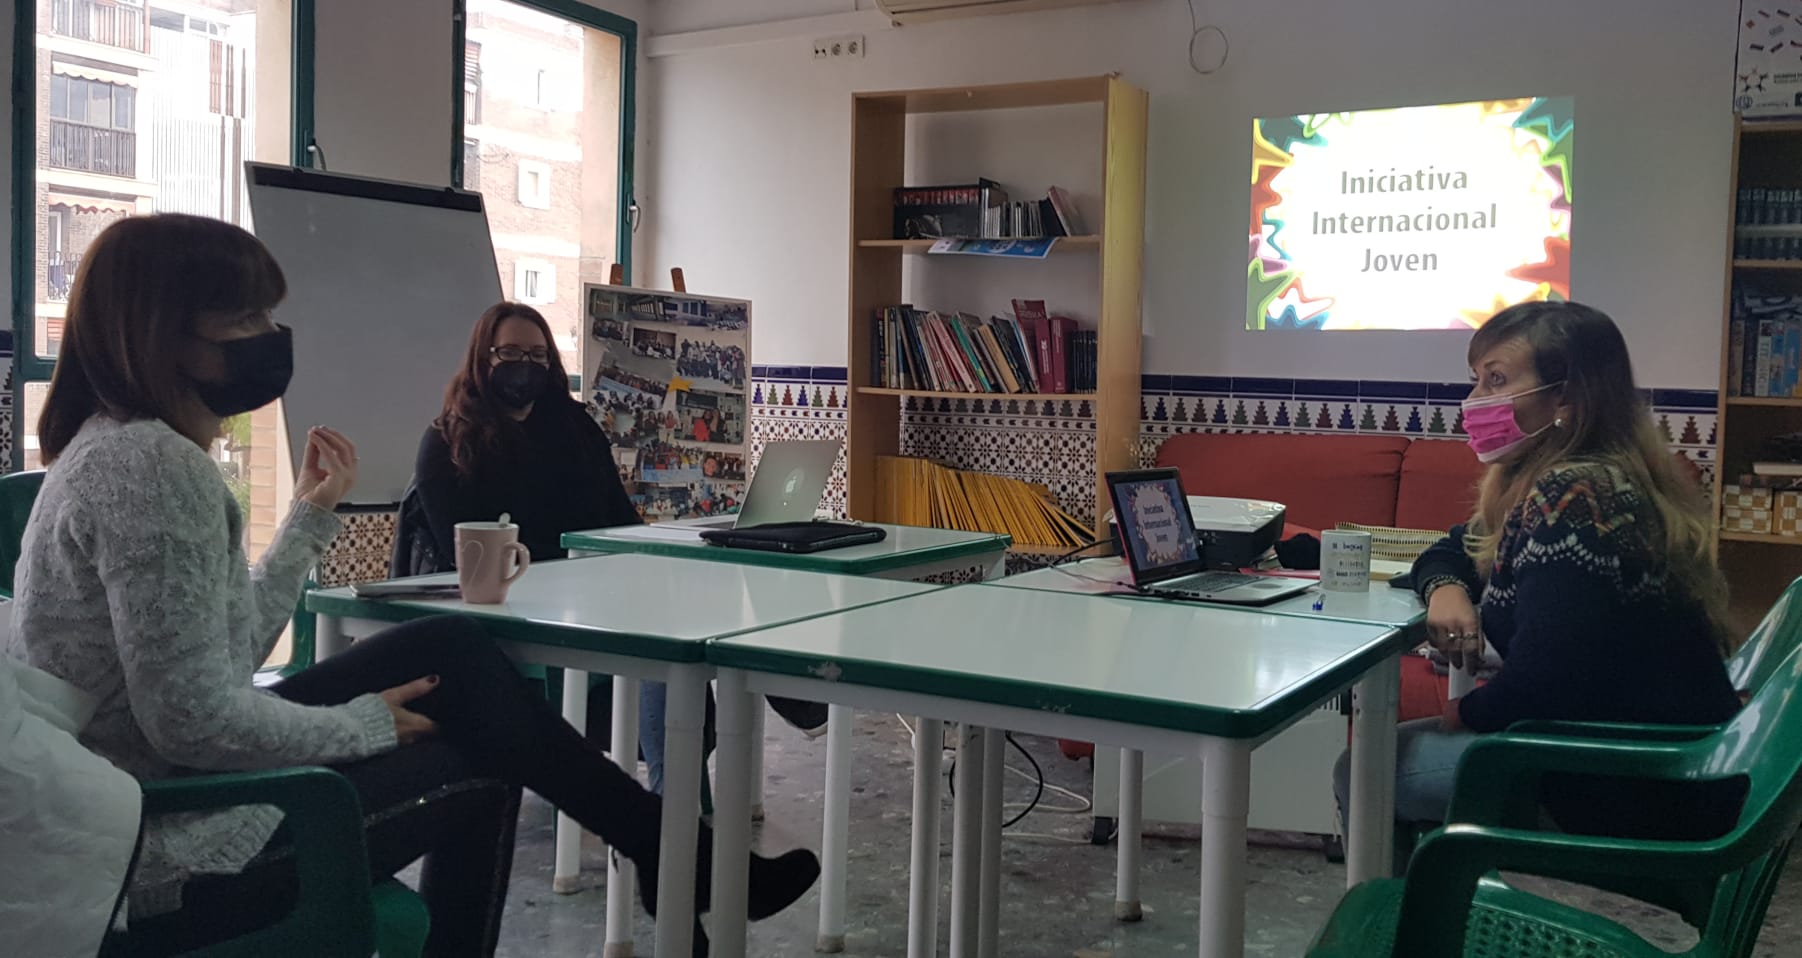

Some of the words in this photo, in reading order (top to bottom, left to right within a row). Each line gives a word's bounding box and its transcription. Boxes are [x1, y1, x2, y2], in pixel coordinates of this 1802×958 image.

[1341, 165, 1467, 194] Iniciativa
[1312, 203, 1496, 234] Internacional
[1360, 248, 1437, 272] Joven
